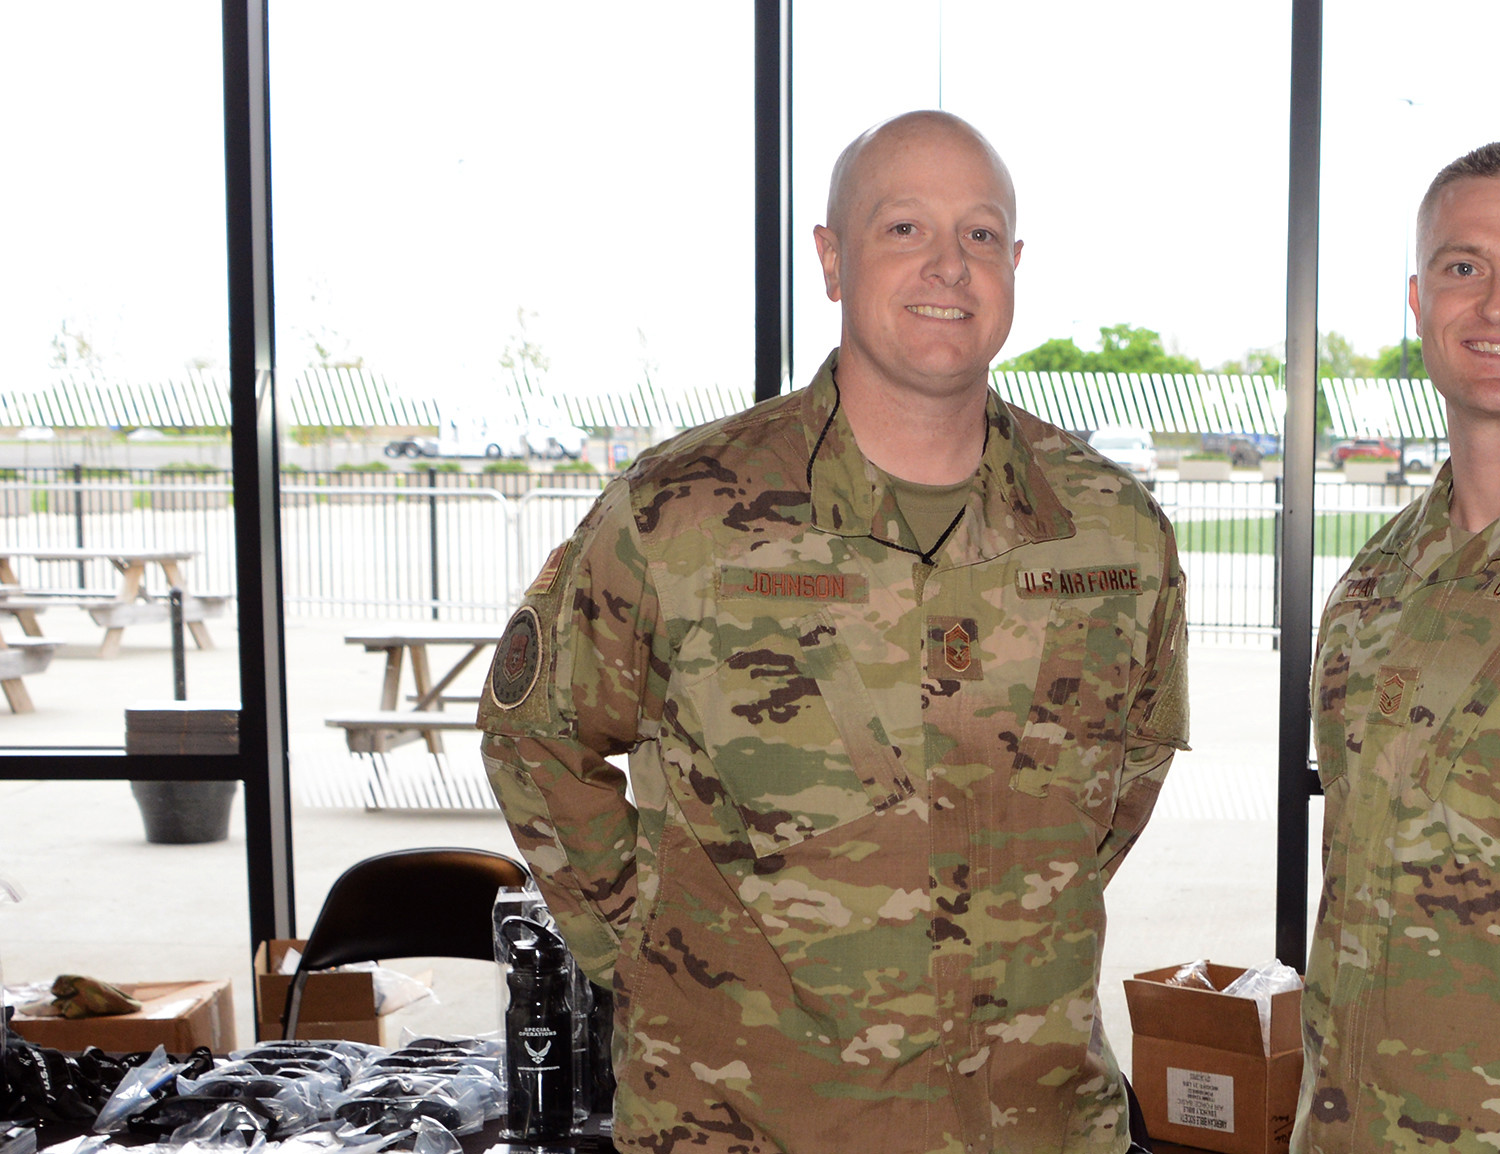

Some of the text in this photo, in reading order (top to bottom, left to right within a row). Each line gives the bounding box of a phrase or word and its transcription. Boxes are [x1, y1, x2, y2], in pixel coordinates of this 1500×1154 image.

[745, 572, 845, 599] JOHNSON
[1024, 568, 1140, 594] U.S. AIR FORCE
